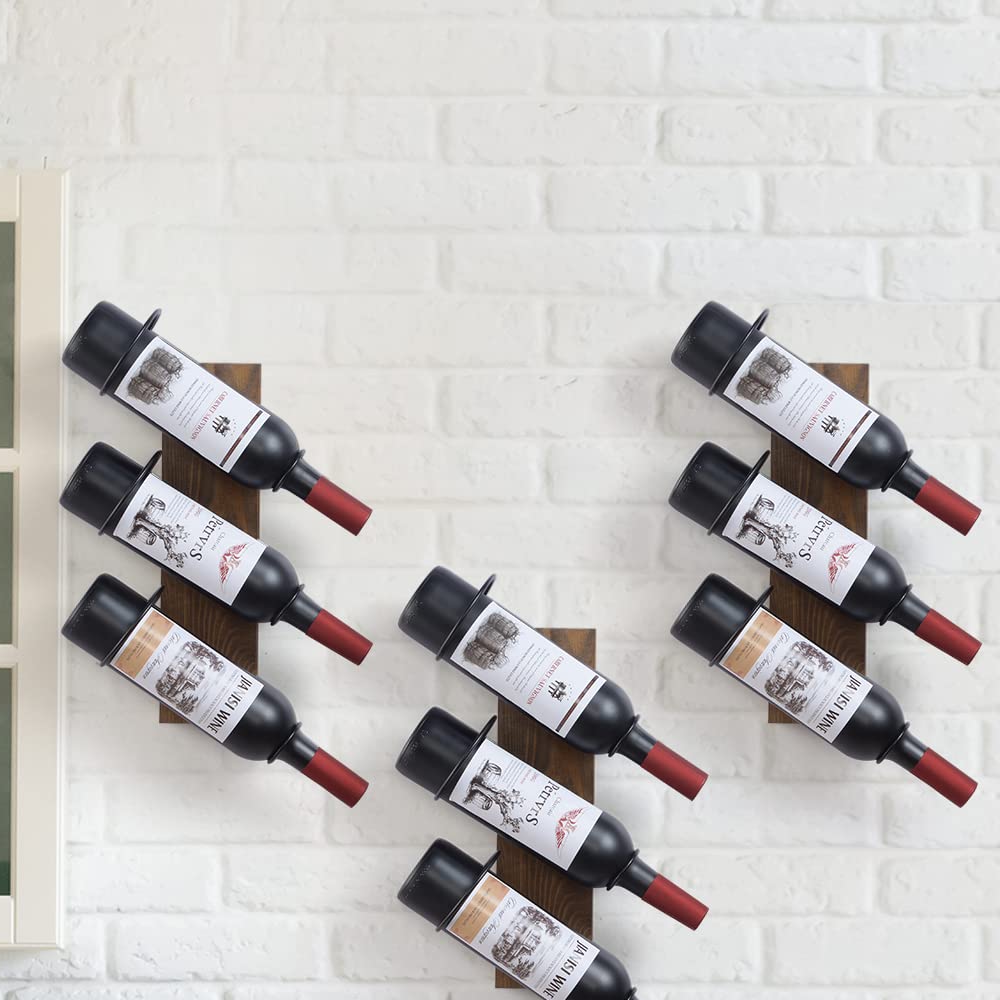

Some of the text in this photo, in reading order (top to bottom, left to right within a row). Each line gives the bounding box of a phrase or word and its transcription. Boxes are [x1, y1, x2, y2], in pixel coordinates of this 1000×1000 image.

[206, 708, 231, 734] WINE
[815, 708, 840, 734] WINE
[542, 973, 567, 999] WINE
